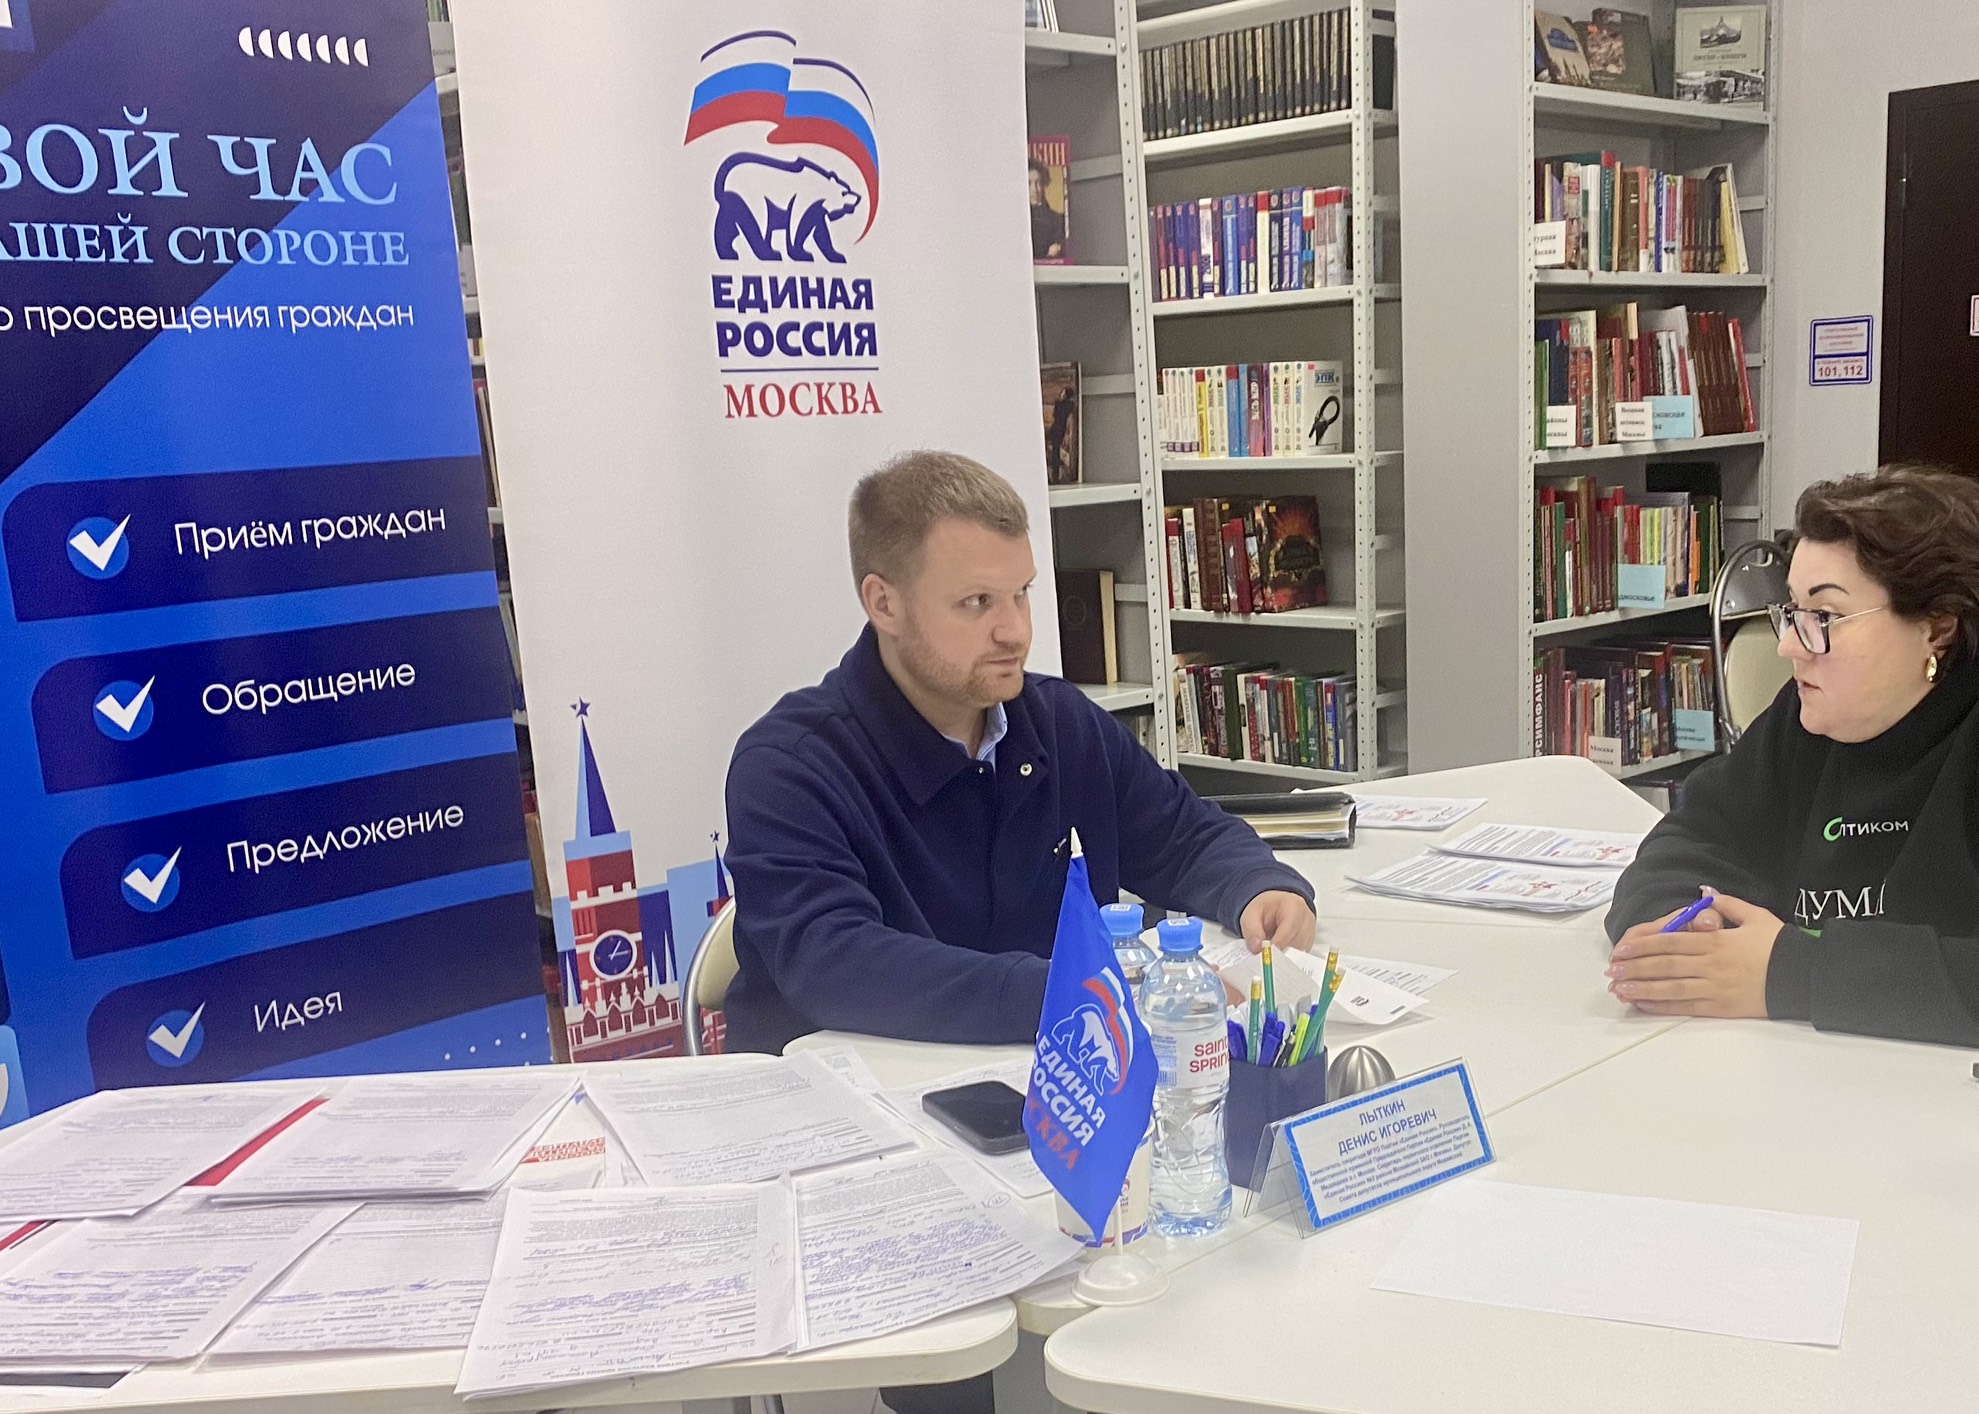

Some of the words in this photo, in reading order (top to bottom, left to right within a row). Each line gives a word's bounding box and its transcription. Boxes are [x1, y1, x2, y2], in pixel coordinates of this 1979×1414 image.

[207, 135, 398, 205] ЧАС
[168, 226, 410, 266] СТОРОНЕ
[711, 274, 875, 314] ЕДИНАЯ
[24, 304, 270, 338] просвещения
[277, 303, 415, 335] граждан
[716, 320, 878, 358] РОССИЯ
[723, 380, 884, 419] МОСКВА
[174, 518, 293, 559] Приём
[301, 506, 447, 550] граждан
[202, 661, 417, 717] Обращение
[227, 803, 466, 874] Предложение
[254, 990, 344, 1033] Идея
[1038, 1035, 1106, 1129] ЕДИНАЯ
[1338, 1129, 1378, 1156] ДЕНИС
[1380, 1109, 1437, 1138] ИГОРЕВИЧ
[1359, 1099, 1406, 1126] ЛЫТКИН
